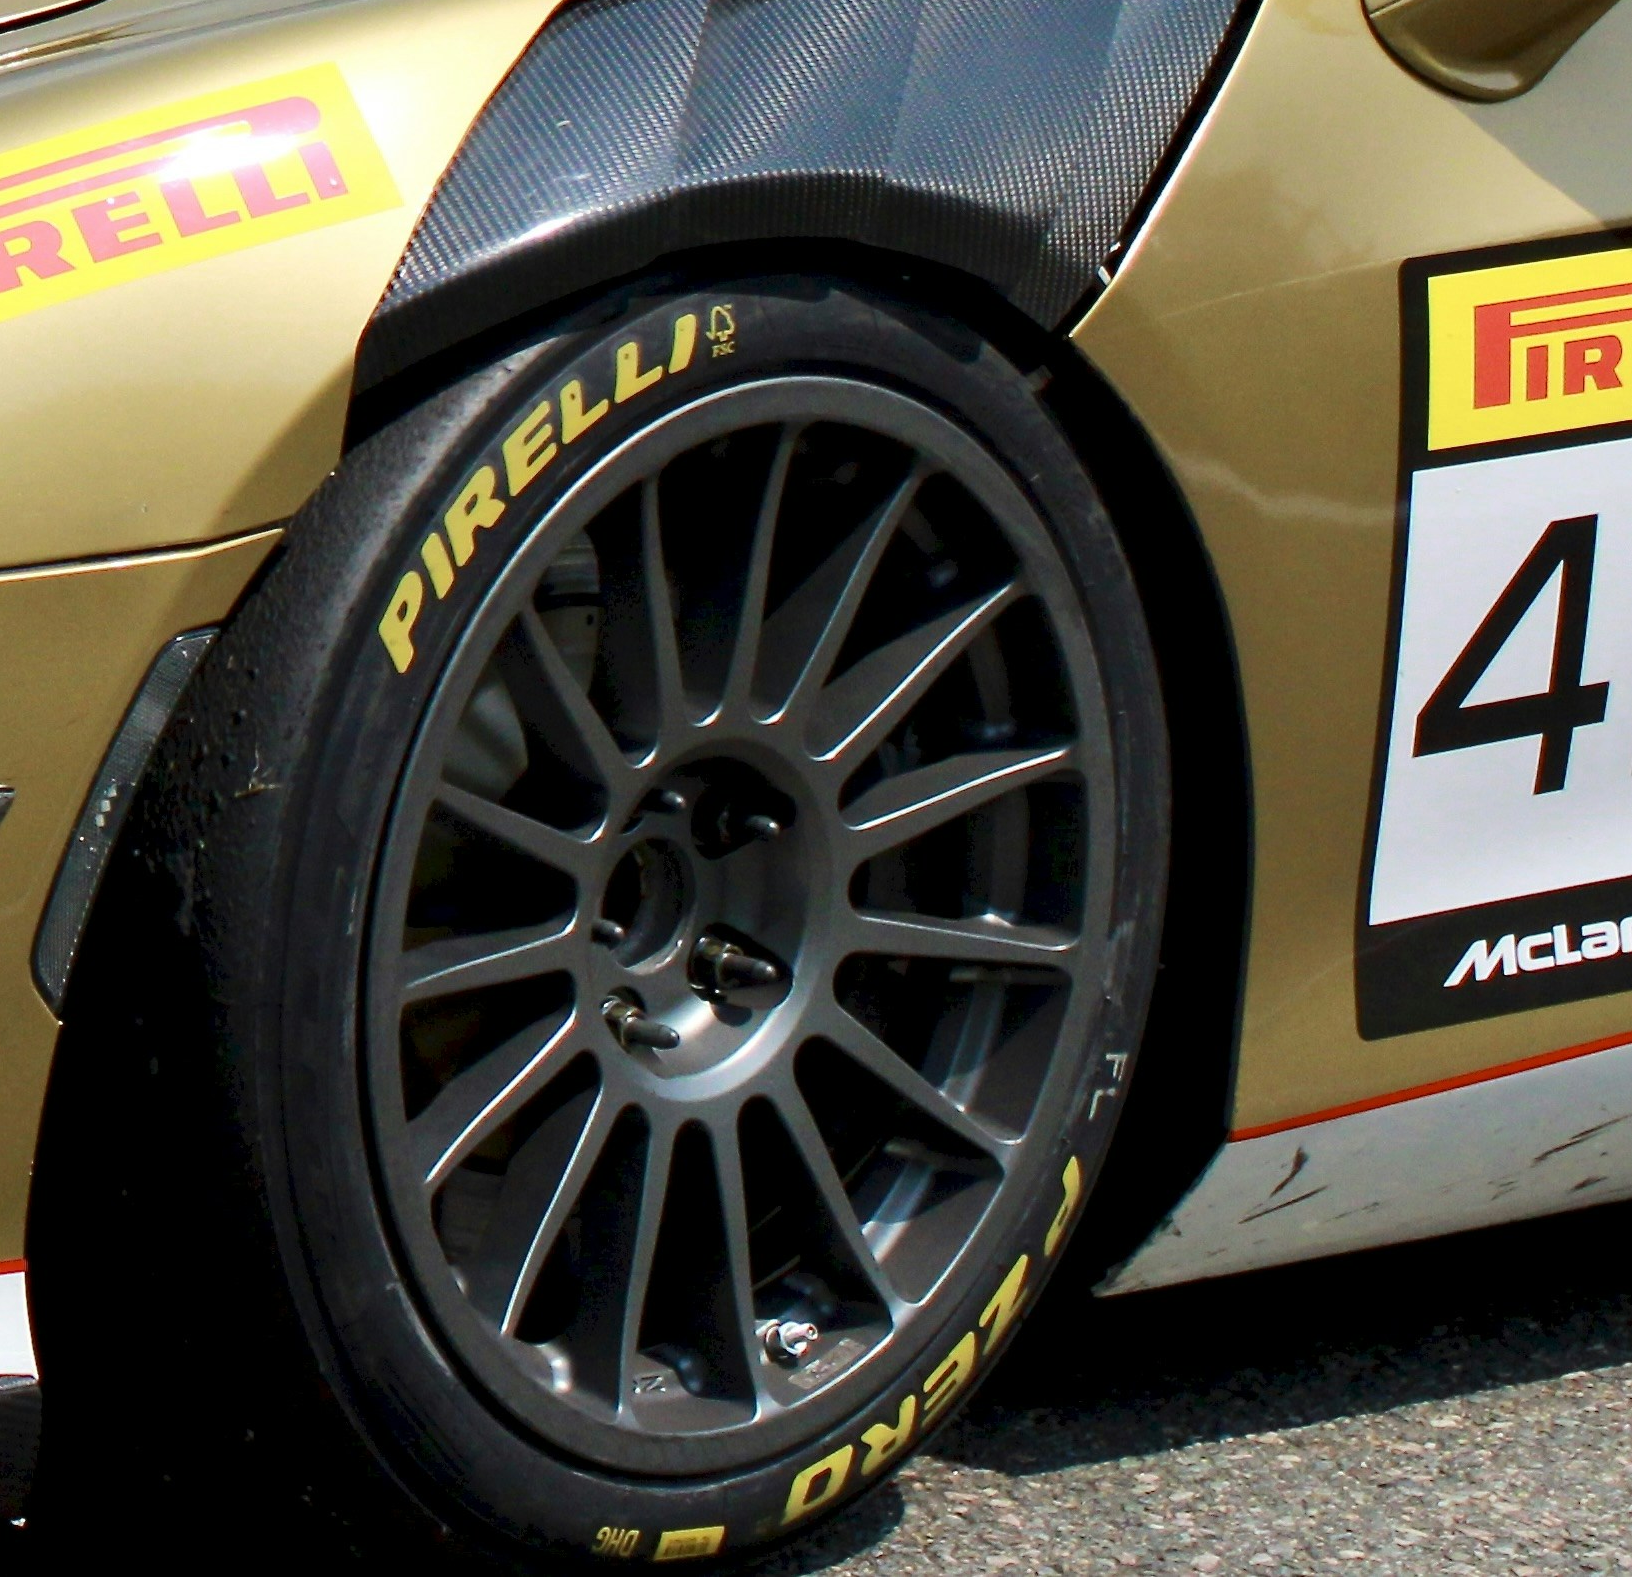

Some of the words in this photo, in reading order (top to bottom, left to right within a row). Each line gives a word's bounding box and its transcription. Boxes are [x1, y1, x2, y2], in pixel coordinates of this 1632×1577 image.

[377, 312, 699, 675] PIRELLI
[1443, 915, 1632, 989] McLa
[781, 1253, 1030, 1526] ZERO
